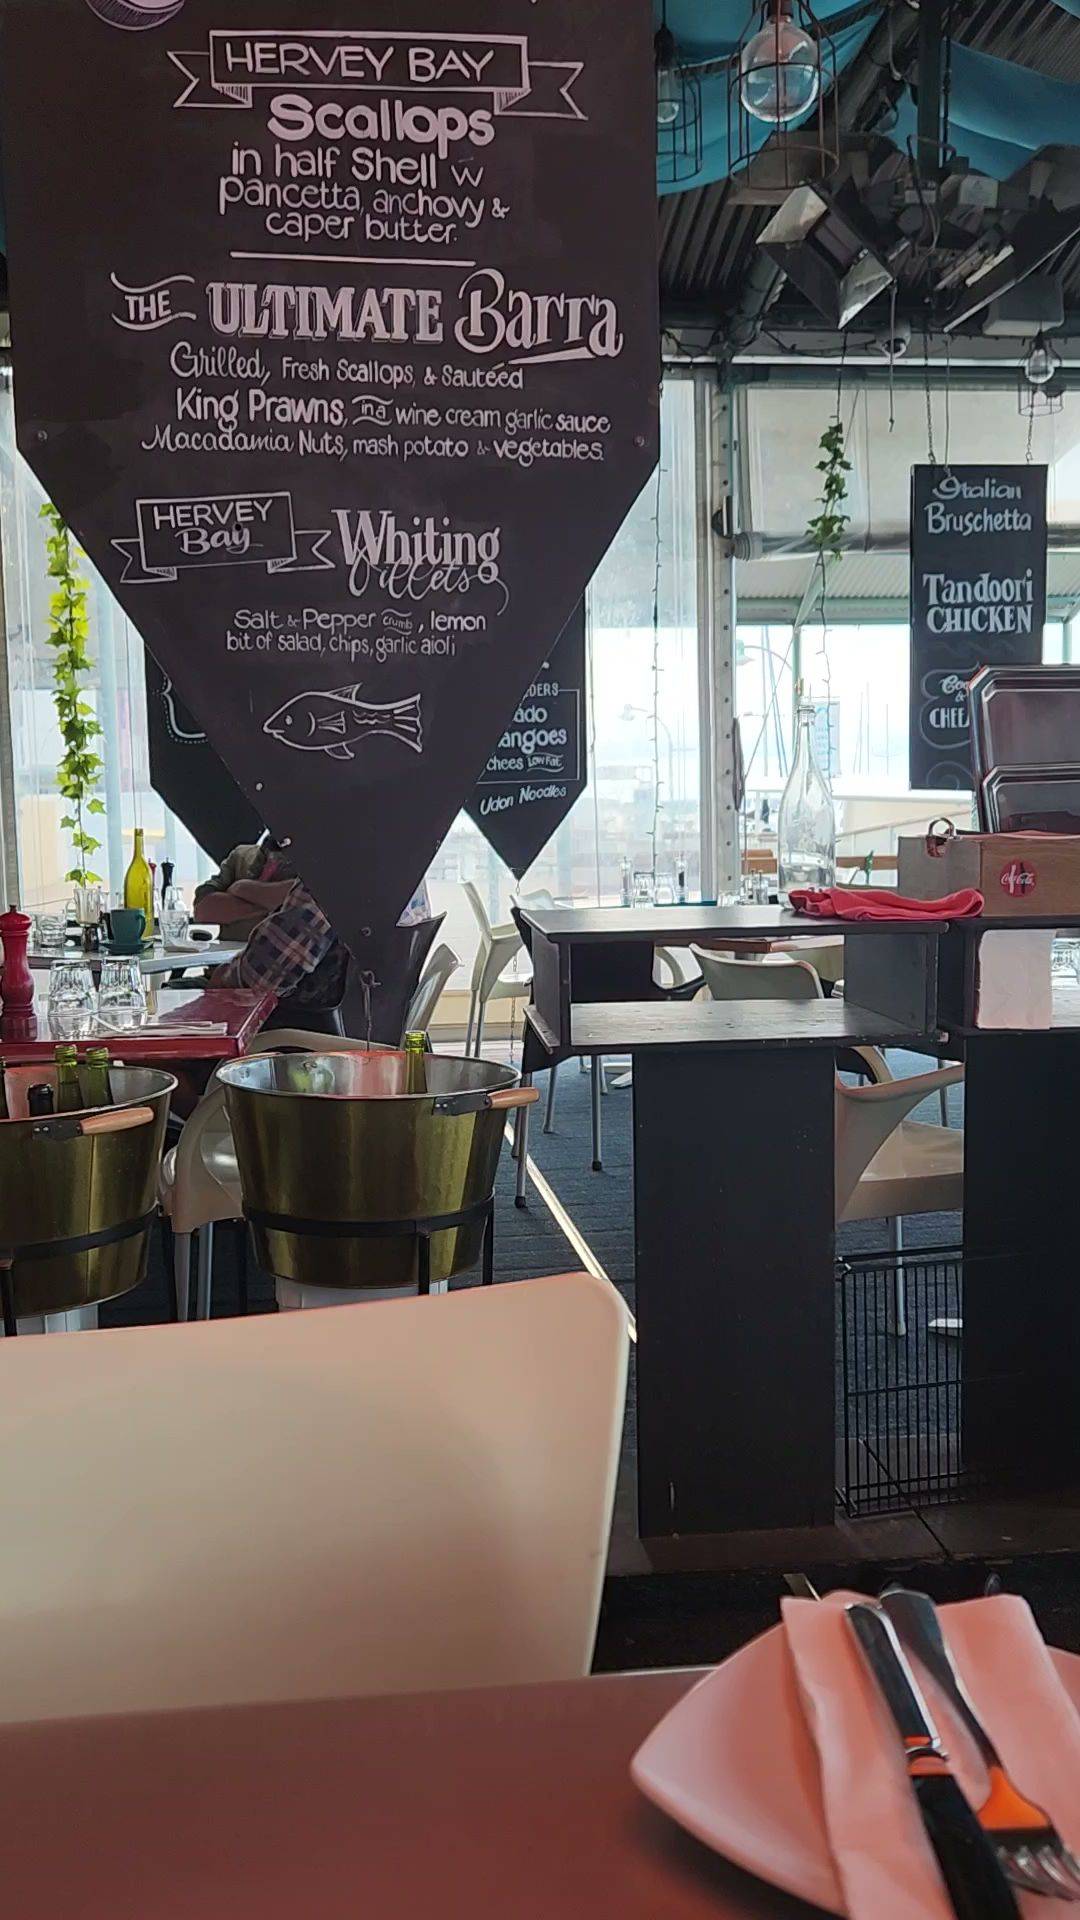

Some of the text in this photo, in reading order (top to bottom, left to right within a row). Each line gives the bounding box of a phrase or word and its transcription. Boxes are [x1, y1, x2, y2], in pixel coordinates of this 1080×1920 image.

[226, 42, 494, 82] HERVEY BAY
[267, 94, 495, 159] Scallops
[231, 142, 262, 176] in
[275, 144, 341, 180] half
[351, 147, 437, 188] Shell
[219, 178, 510, 228] pancetta, anchovy &
[266, 212, 458, 243] caper butter.
[124, 267, 624, 364] THE ULTIMATE Barra
[170, 341, 271, 387] Grilled,
[282, 356, 330, 382] Fresh
[424, 366, 438, 386] &
[176, 386, 611, 435] King Prawns, in a wine cream garlic sauce
[141, 423, 294, 452] Macadamia
[299, 429, 348, 462] Nuts,
[353, 434, 399, 456] mash
[403, 435, 469, 461] potato
[932, 475, 1022, 500] Italian
[153, 499, 272, 530] HERVEY
[924, 502, 1033, 537] Bruschetta
[174, 524, 257, 555] Bay
[330, 508, 501, 585] Whiting
[922, 568, 1034, 605] Tandoori
[233, 609, 284, 631] Salt
[286, 614, 301, 627] &
[302, 607, 377, 635] Pepper
[430, 610, 487, 632] lemon
[926, 604, 1034, 634] CHICKEN
[226, 631, 457, 663] bit of salad, chips, garlic aioli
[526, 682, 560, 698] DERS
[480, 785, 567, 816] Udon Noodles
